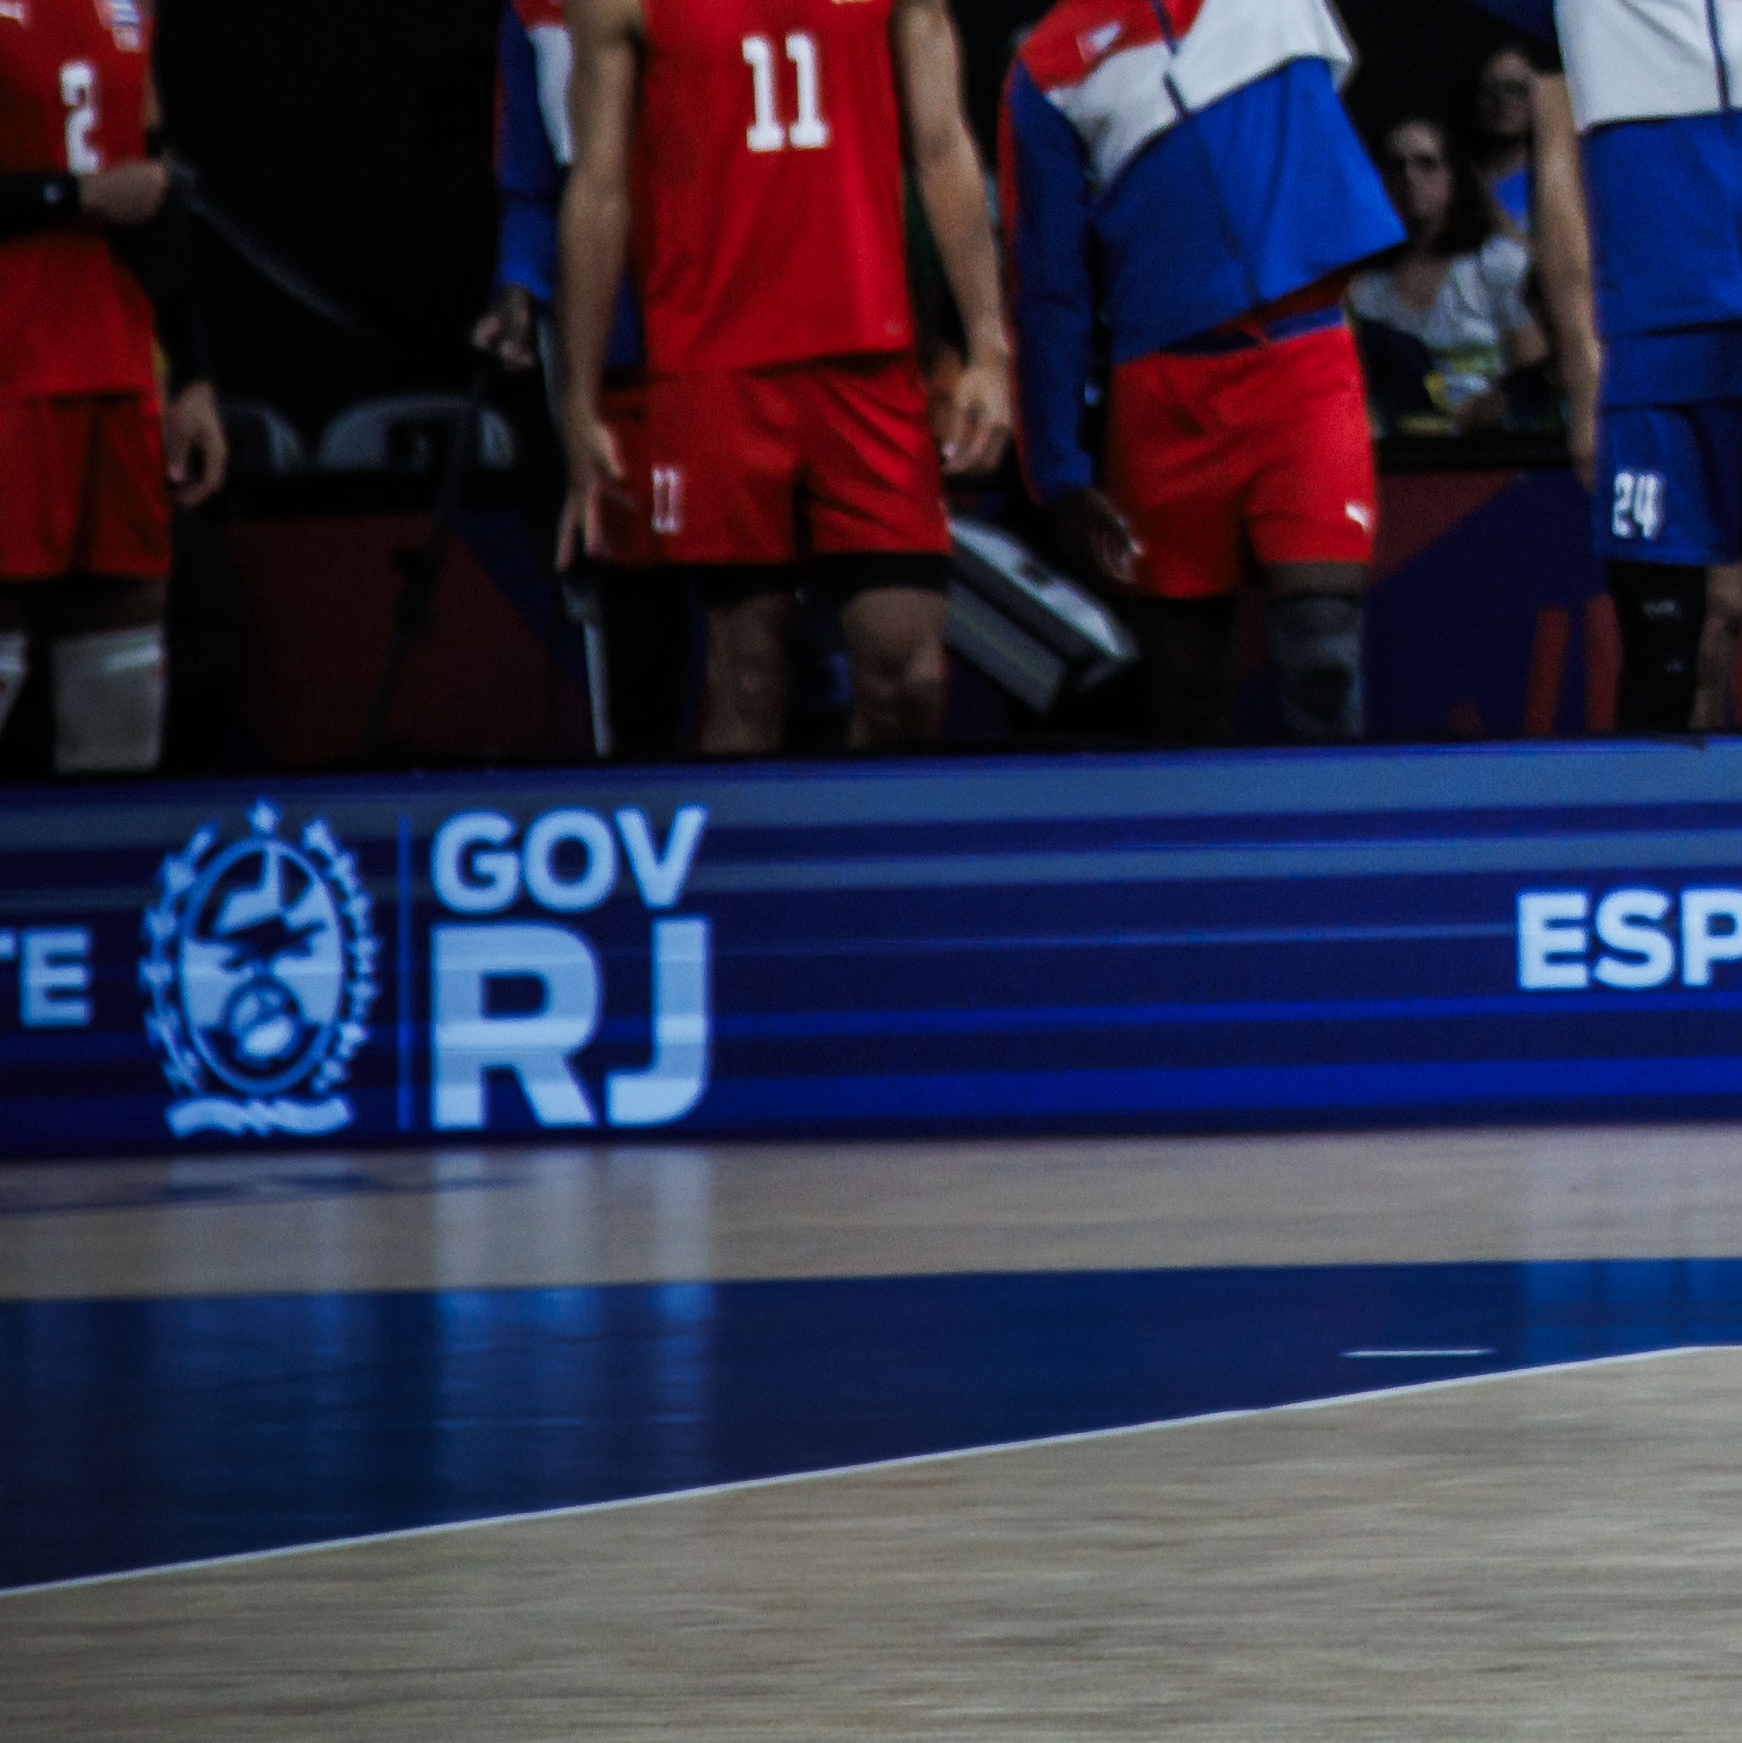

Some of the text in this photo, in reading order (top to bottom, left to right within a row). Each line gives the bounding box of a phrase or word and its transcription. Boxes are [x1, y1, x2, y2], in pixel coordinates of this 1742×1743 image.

[59, 60, 102, 175] 2
[741, 32, 831, 154] 11
[1612, 471, 1664, 540] 24
[431, 804, 708, 913] GOV
[0, 927, 92, 1026] E
[431, 916, 711, 1130] RJ
